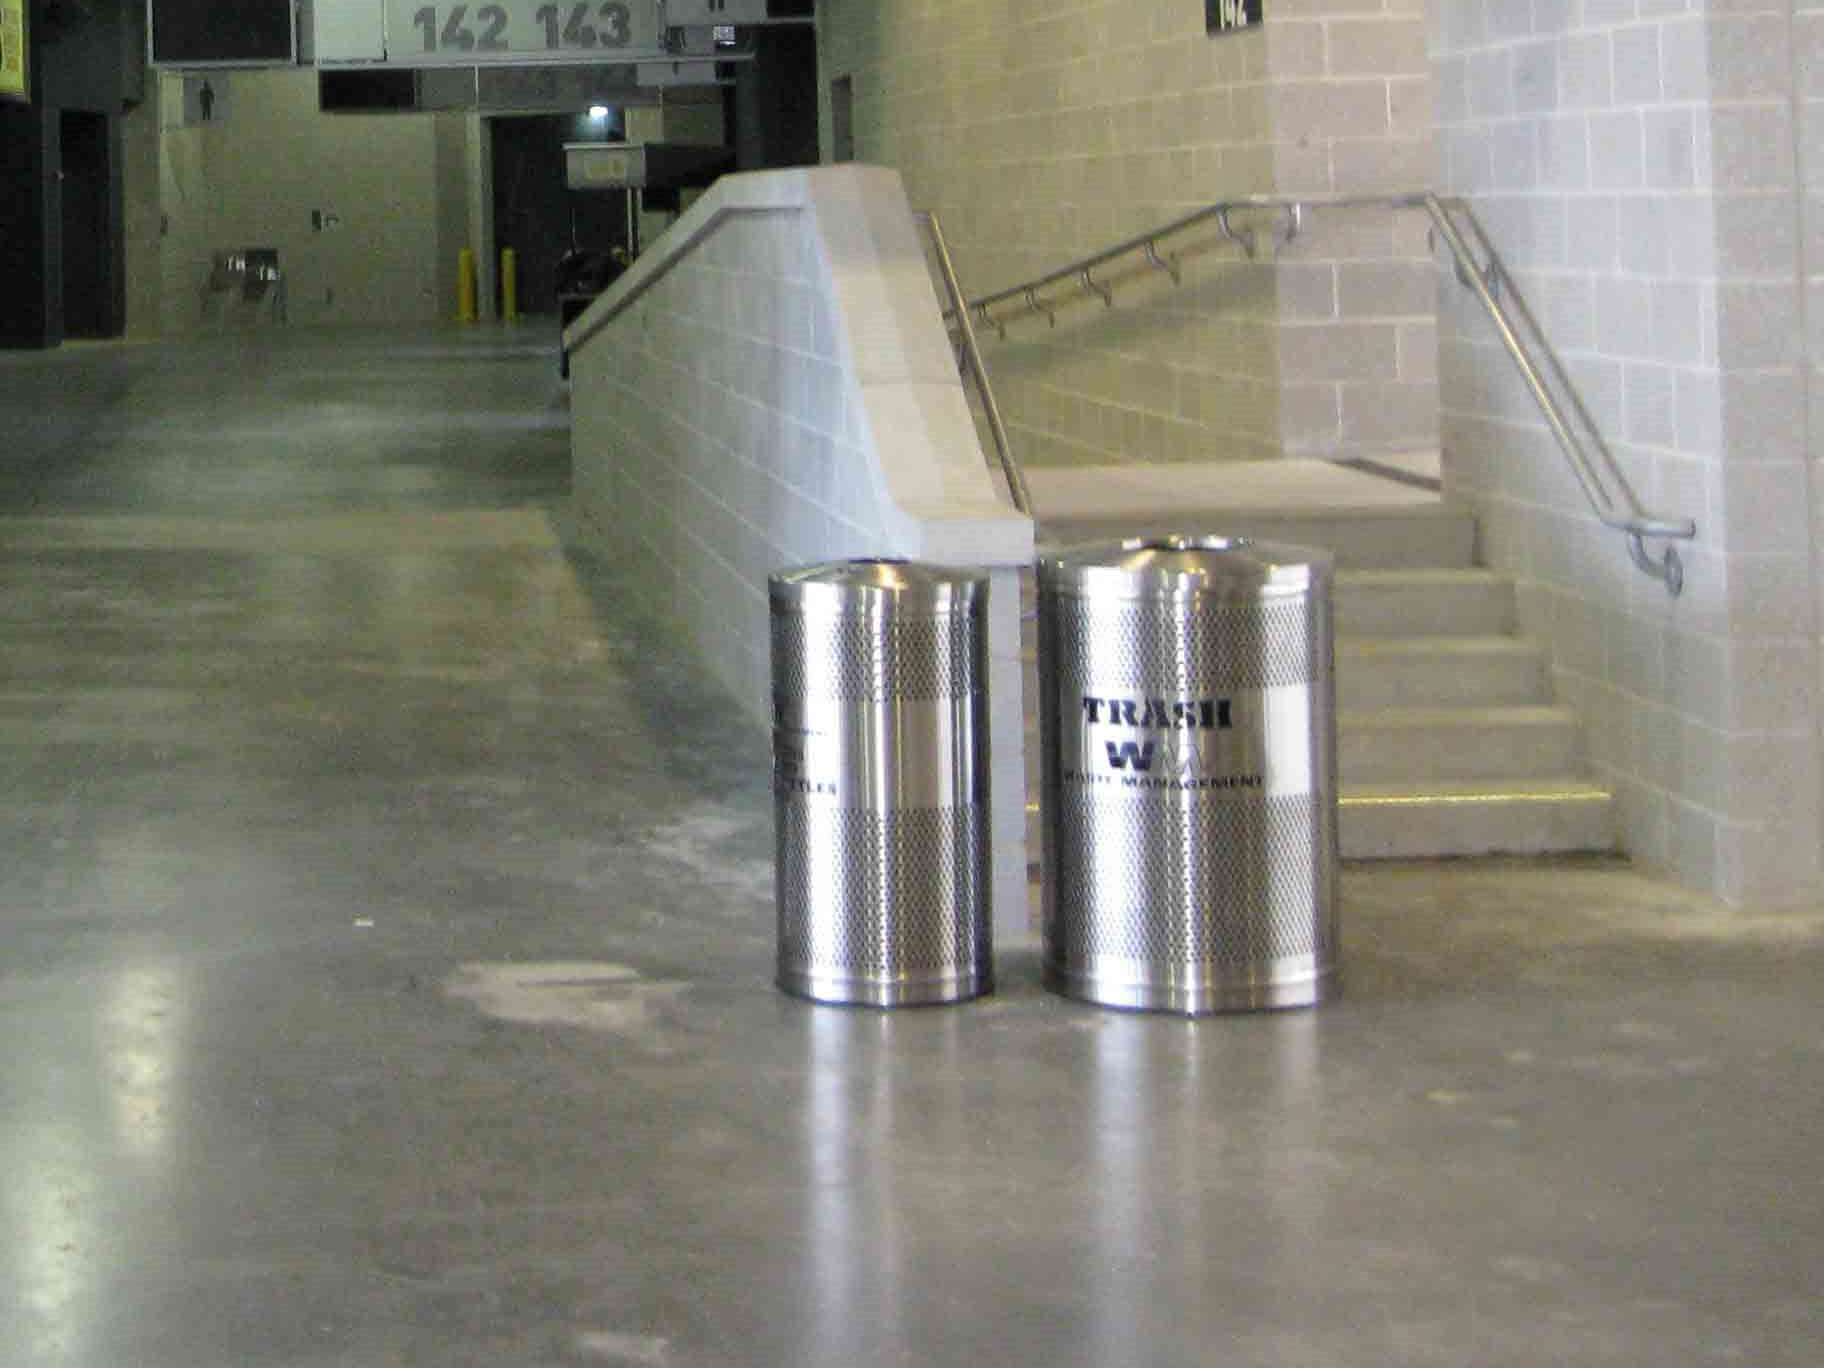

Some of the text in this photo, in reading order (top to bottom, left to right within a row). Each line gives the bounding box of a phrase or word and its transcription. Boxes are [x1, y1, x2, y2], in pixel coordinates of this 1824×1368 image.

[413, 1, 631, 52] 142 143
[1082, 696, 1232, 729] TRASH
[1120, 775, 1263, 789] MANAGEMENT
